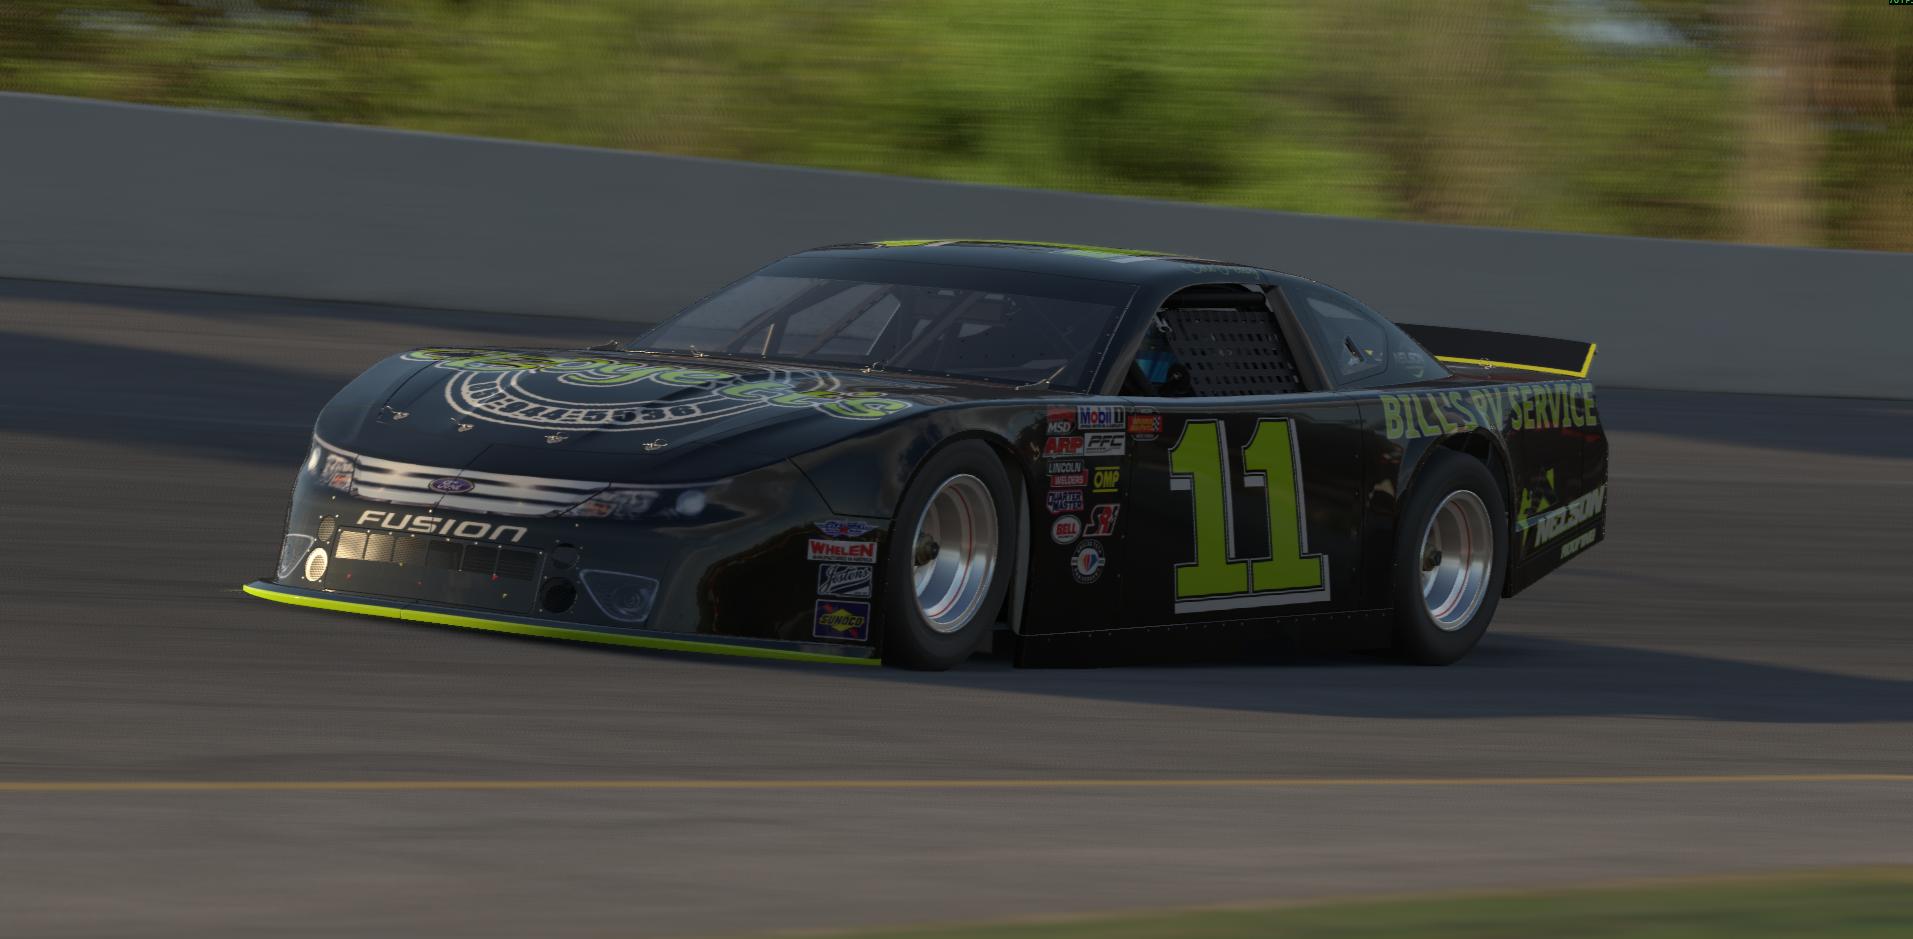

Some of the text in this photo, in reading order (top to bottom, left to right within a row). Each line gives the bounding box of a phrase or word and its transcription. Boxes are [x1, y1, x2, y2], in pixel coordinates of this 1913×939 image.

[1080, 407, 1112, 424] Mobil
[1114, 407, 1125, 424] 1
[1380, 391, 1479, 440] BILL'S
[1506, 382, 1597, 431] SERVICE
[1047, 420, 1071, 433] MSD
[1045, 437, 1083, 454] ARP
[1087, 435, 1125, 447] PFC
[1048, 462, 1082, 473] LINCOLN
[1093, 470, 1120, 488] OMP
[1170, 418, 1330, 612] 11
[1533, 485, 1607, 548] NELSON
[356, 509, 528, 543] FUSION
[1056, 523, 1076, 535] BELL
[811, 541, 874, 557] WHELEN
[819, 614, 865, 626] SUNOCO
